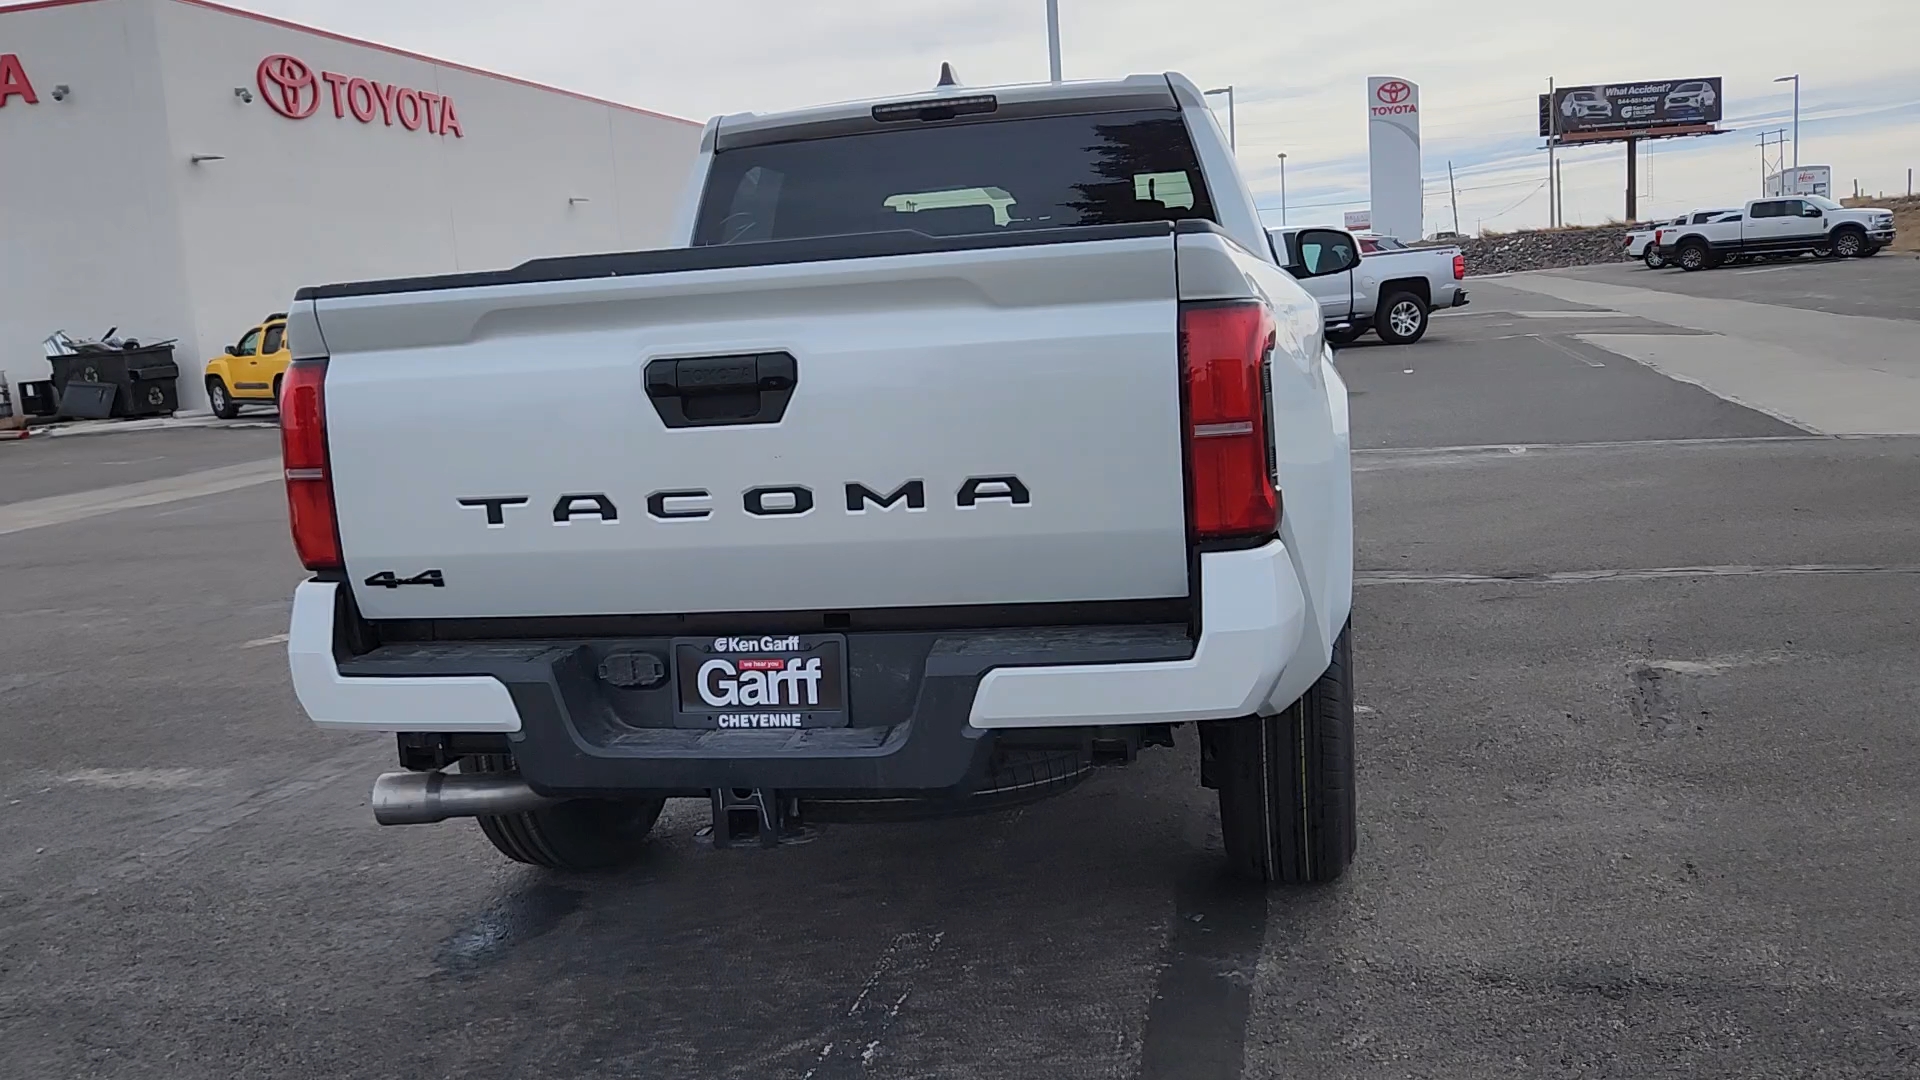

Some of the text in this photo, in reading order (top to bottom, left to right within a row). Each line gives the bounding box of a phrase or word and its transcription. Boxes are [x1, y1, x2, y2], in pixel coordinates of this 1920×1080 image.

[1605, 83, 1672, 97] What Accident?
[322, 71, 463, 138] TOYOTA
[1371, 104, 1417, 116] TOYOTA
[457, 474, 1032, 528] TACOMA
[728, 636, 799, 652] Ken Garff
[697, 658, 822, 707] Garff
[718, 713, 801, 728] CHEYENNE
